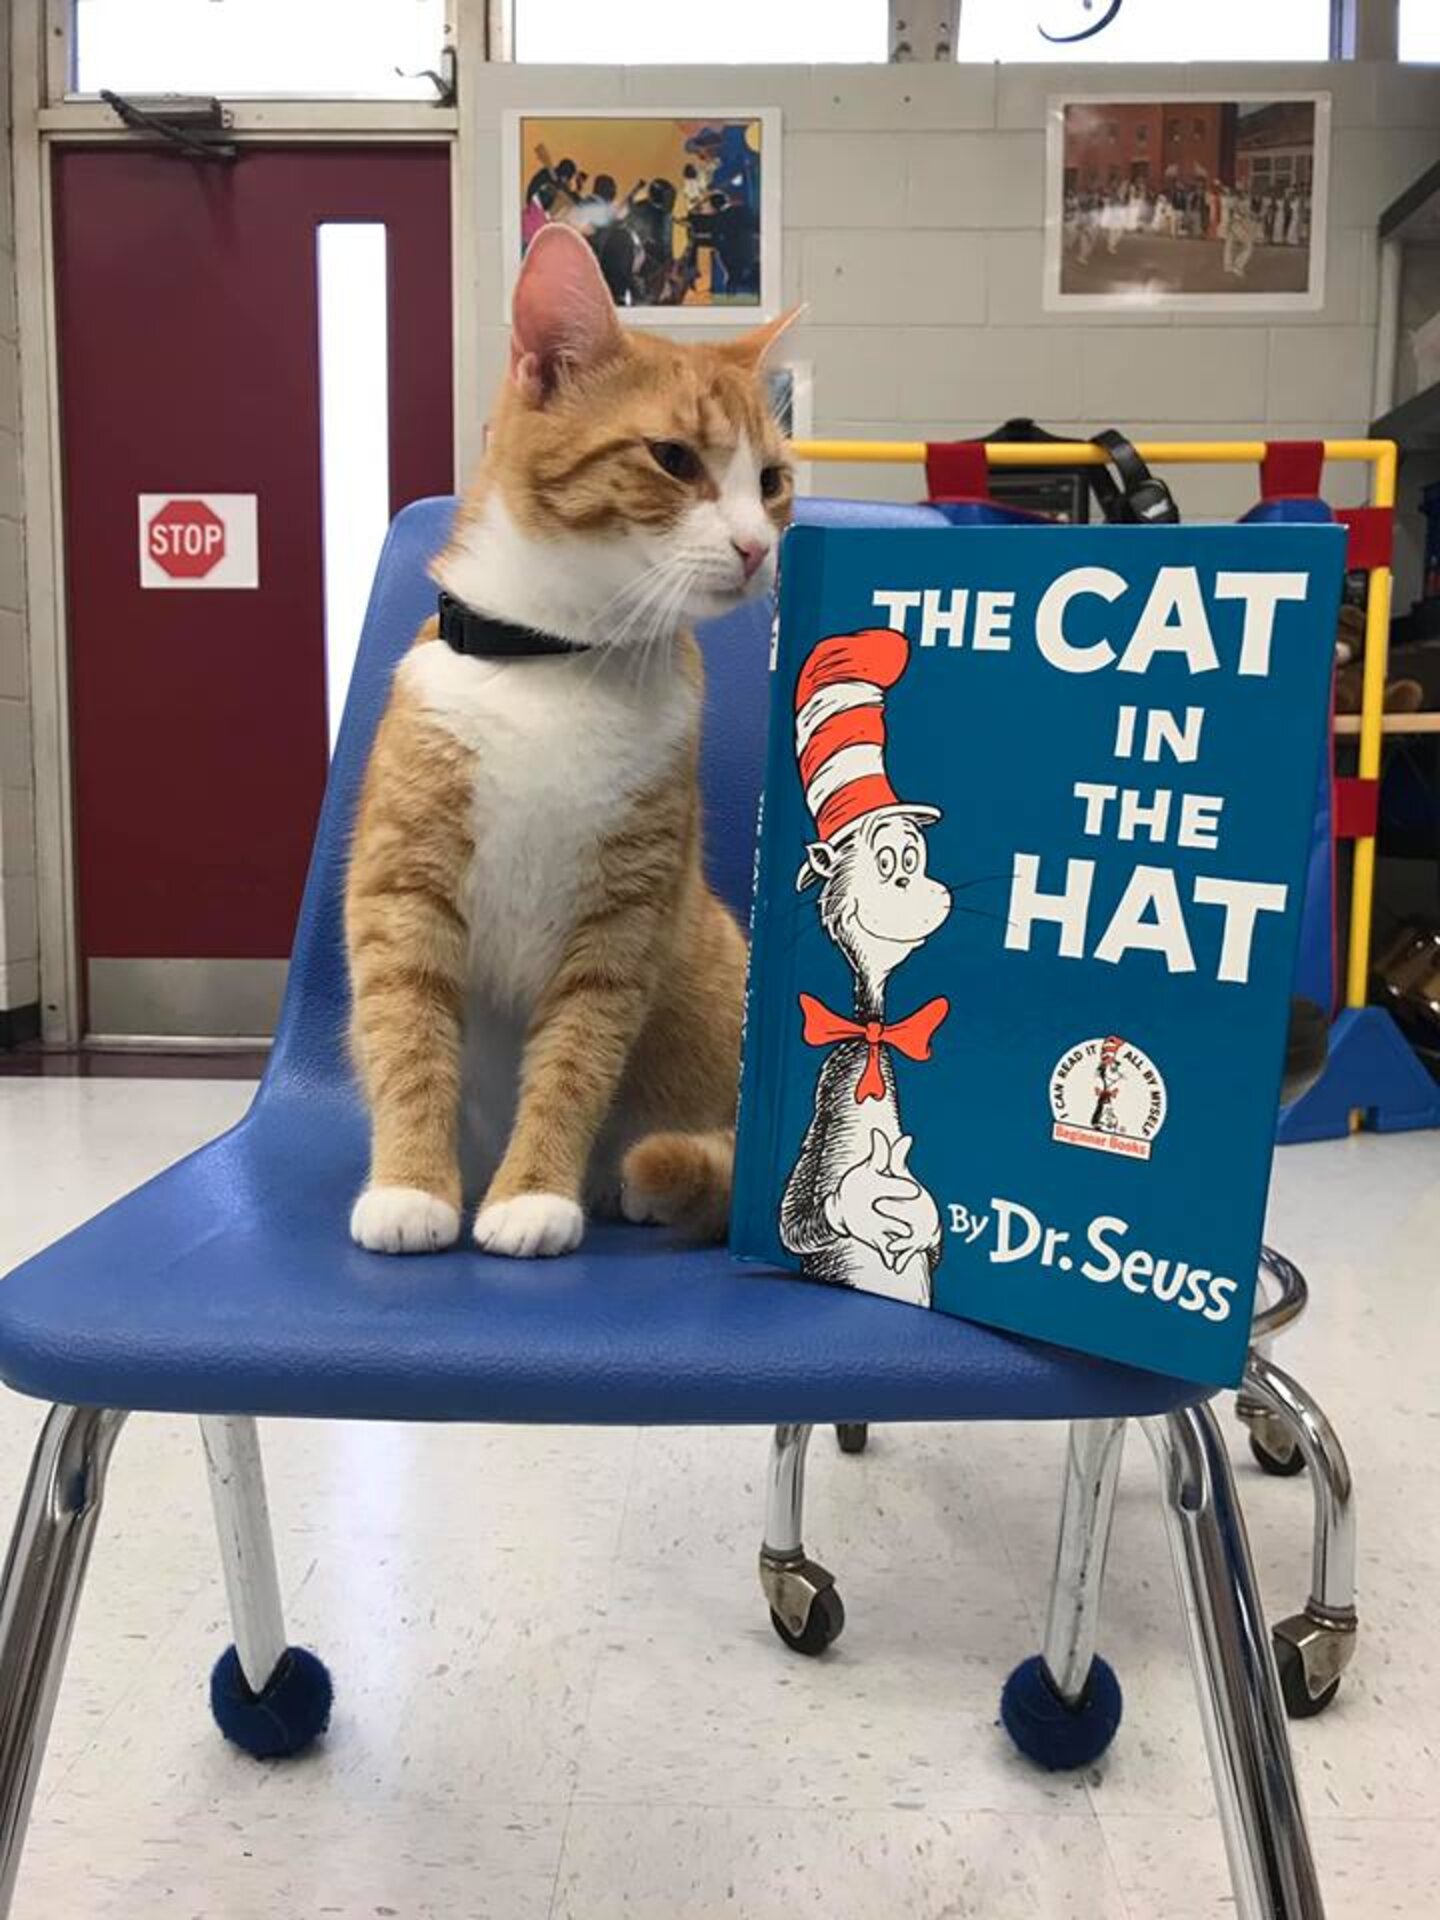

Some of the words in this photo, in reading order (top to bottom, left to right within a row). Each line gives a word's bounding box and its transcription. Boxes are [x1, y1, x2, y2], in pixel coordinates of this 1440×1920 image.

[151, 524, 222, 555] STOP
[872, 589, 1015, 651] THE
[1035, 566, 1309, 676] CAT
[1114, 705, 1204, 763] IN
[1074, 782, 1223, 849] THE
[1004, 853, 1287, 983] HAT
[1057, 1051, 1083, 1078] READ
[1086, 1044, 1097, 1056] IT
[1123, 1050, 1144, 1070] ALL
[1142, 1069, 1158, 1085] BY
[1054, 1083, 1065, 1109] CAN
[1142, 1091, 1162, 1137] MYSELF
[1055, 1126, 1106, 1146] Beginner
[1109, 1138, 1147, 1155] Books
[948, 1203, 988, 1243] By
[990, 1198, 1074, 1271] Dr.
[1082, 1217, 1237, 1321] Seuss
